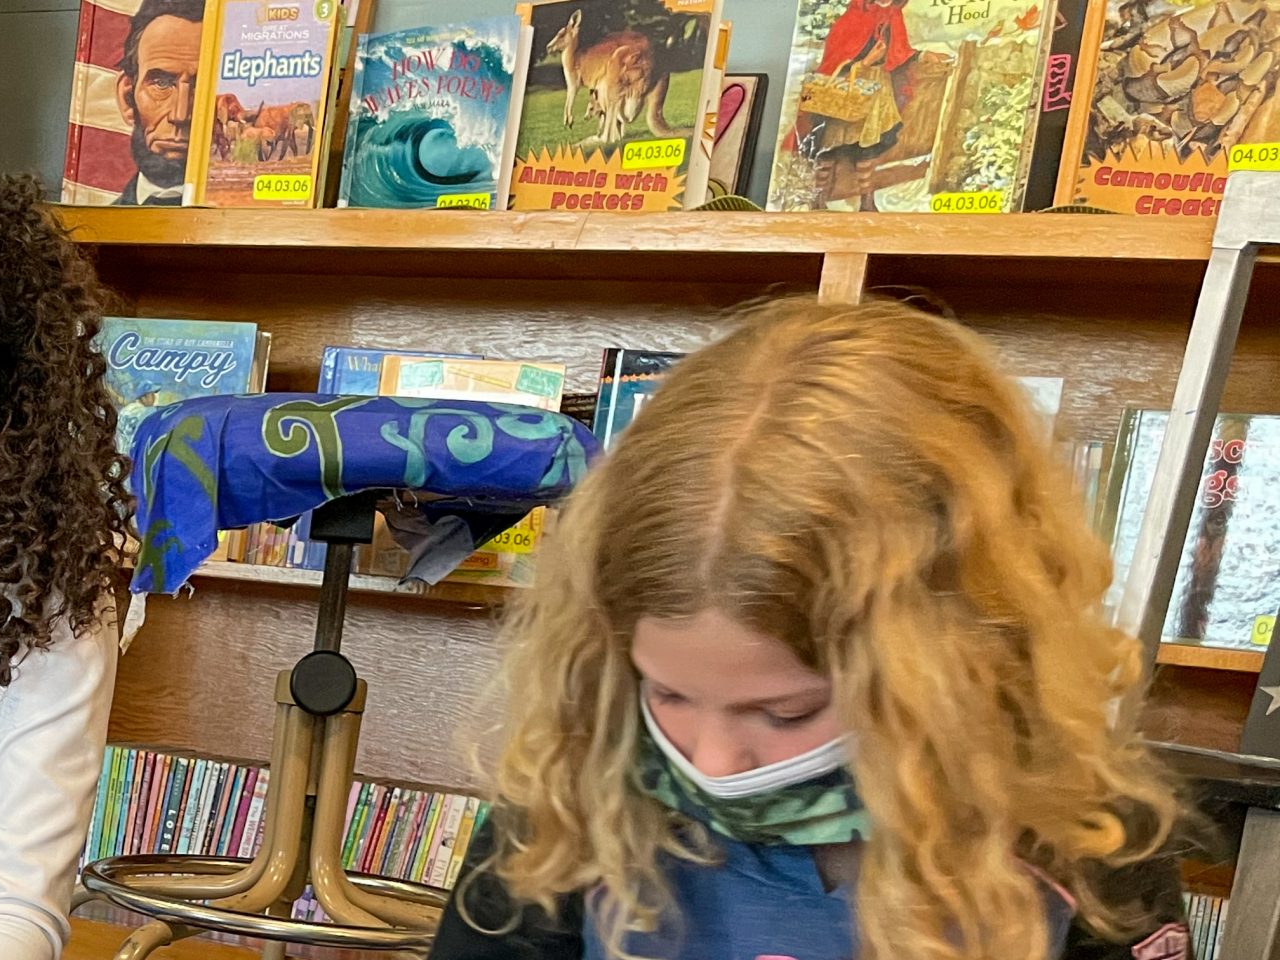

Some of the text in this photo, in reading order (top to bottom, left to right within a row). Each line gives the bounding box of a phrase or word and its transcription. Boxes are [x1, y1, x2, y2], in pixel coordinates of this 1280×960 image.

[268, 8, 299, 20] KIDS
[320, 3, 329, 17] 3
[945, 1, 991, 26] Hood
[241, 30, 310, 40] MIGRATIONS
[222, 49, 322, 86] Elephants
[393, 47, 481, 81] HOW DO
[363, 78, 431, 114] WAVES
[625, 143, 682, 161] 04.03.06
[1233, 147, 1280, 163] 04.03
[256, 180, 308, 192] 04.03.06
[519, 166, 669, 192] Animals with
[1094, 166, 1227, 194] Camoufla
[550, 190, 645, 211] Pockets
[933, 195, 998, 212] 04.03.06
[108, 331, 236, 388] Campy
[347, 356, 380, 373] Wha
[493, 533, 531, 547] 03.06
